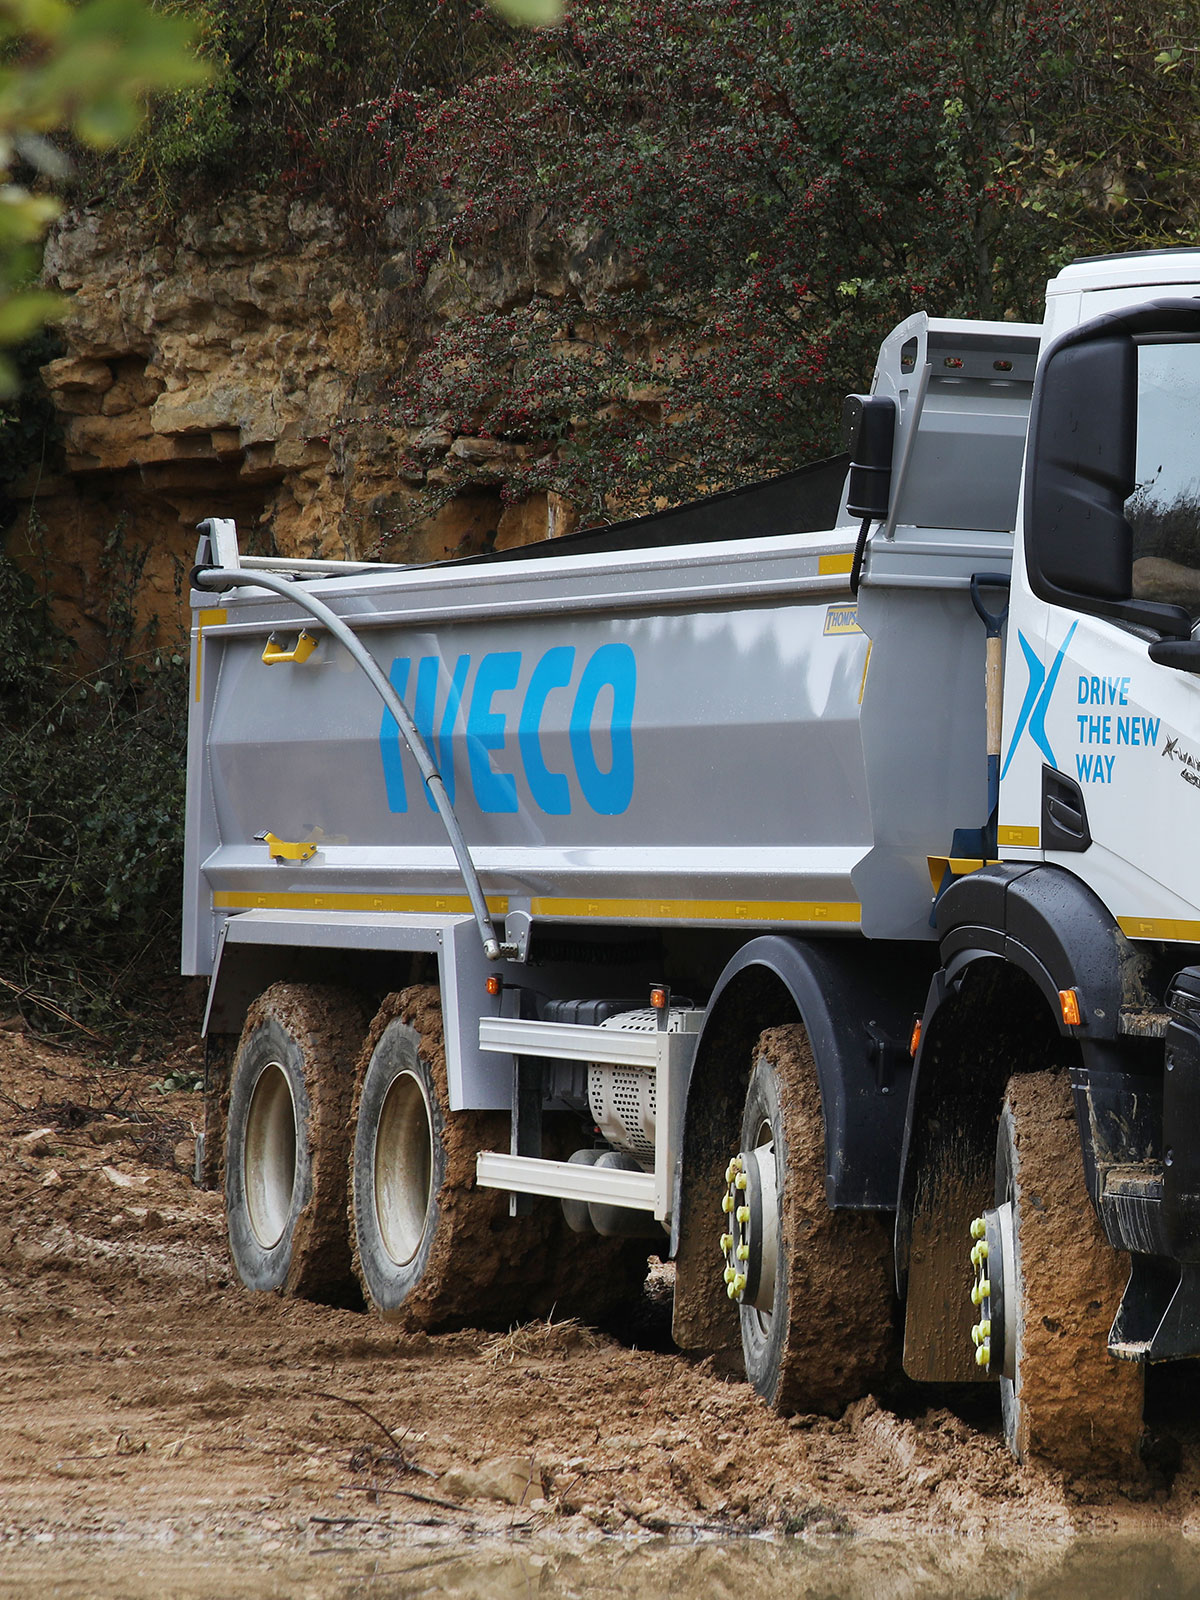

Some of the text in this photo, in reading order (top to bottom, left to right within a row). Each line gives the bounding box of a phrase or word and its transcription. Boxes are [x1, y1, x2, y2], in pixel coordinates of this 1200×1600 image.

[1077, 676, 1131, 706] DRIVE
[379, 642, 637, 816] IVECO
[1077, 715, 1161, 747] THE NEW
[1075, 754, 1116, 784] WAY
